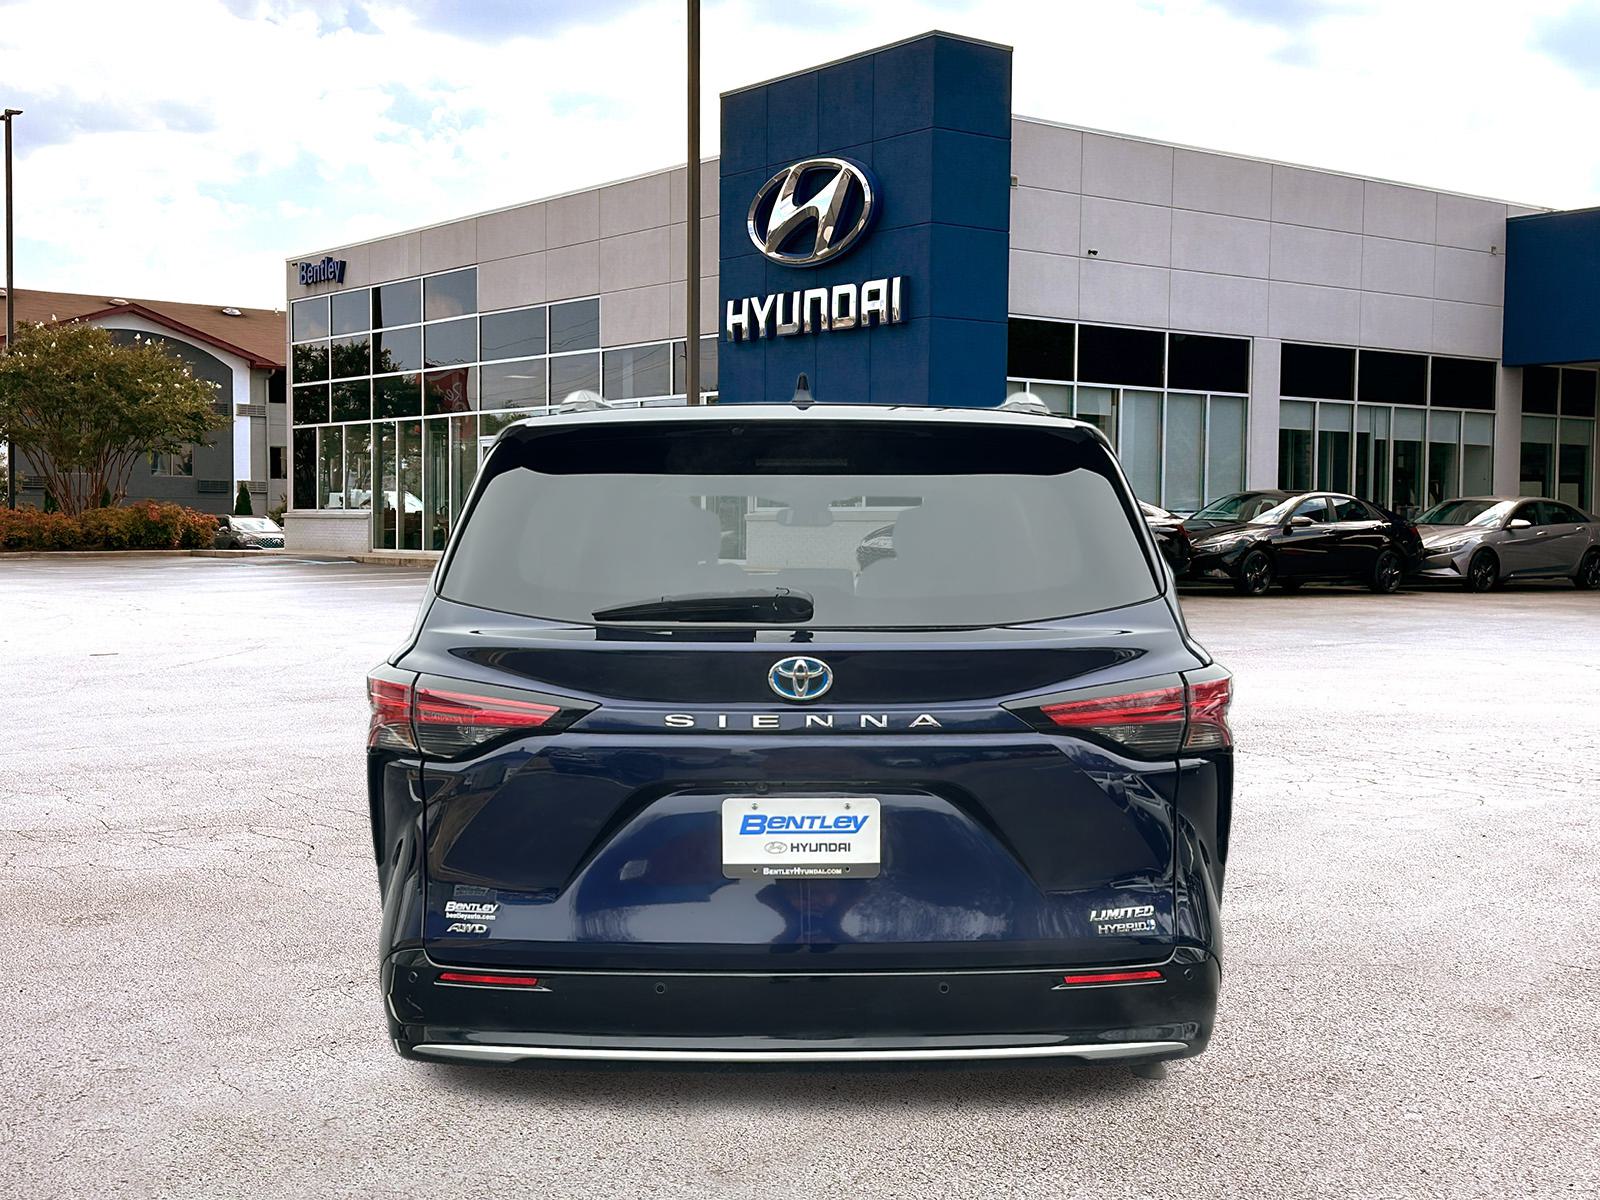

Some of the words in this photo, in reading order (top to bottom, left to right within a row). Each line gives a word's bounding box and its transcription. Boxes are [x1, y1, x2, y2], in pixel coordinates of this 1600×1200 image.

[299, 257, 346, 285] Bentley
[726, 276, 903, 342] HYUNDAI
[664, 714, 942, 728] SIENNA
[790, 842, 851, 853] HYUNDAI
[1090, 905, 1154, 921] LIMITED
[447, 922, 488, 933] AWD
[1098, 921, 1147, 934] HYBRID
